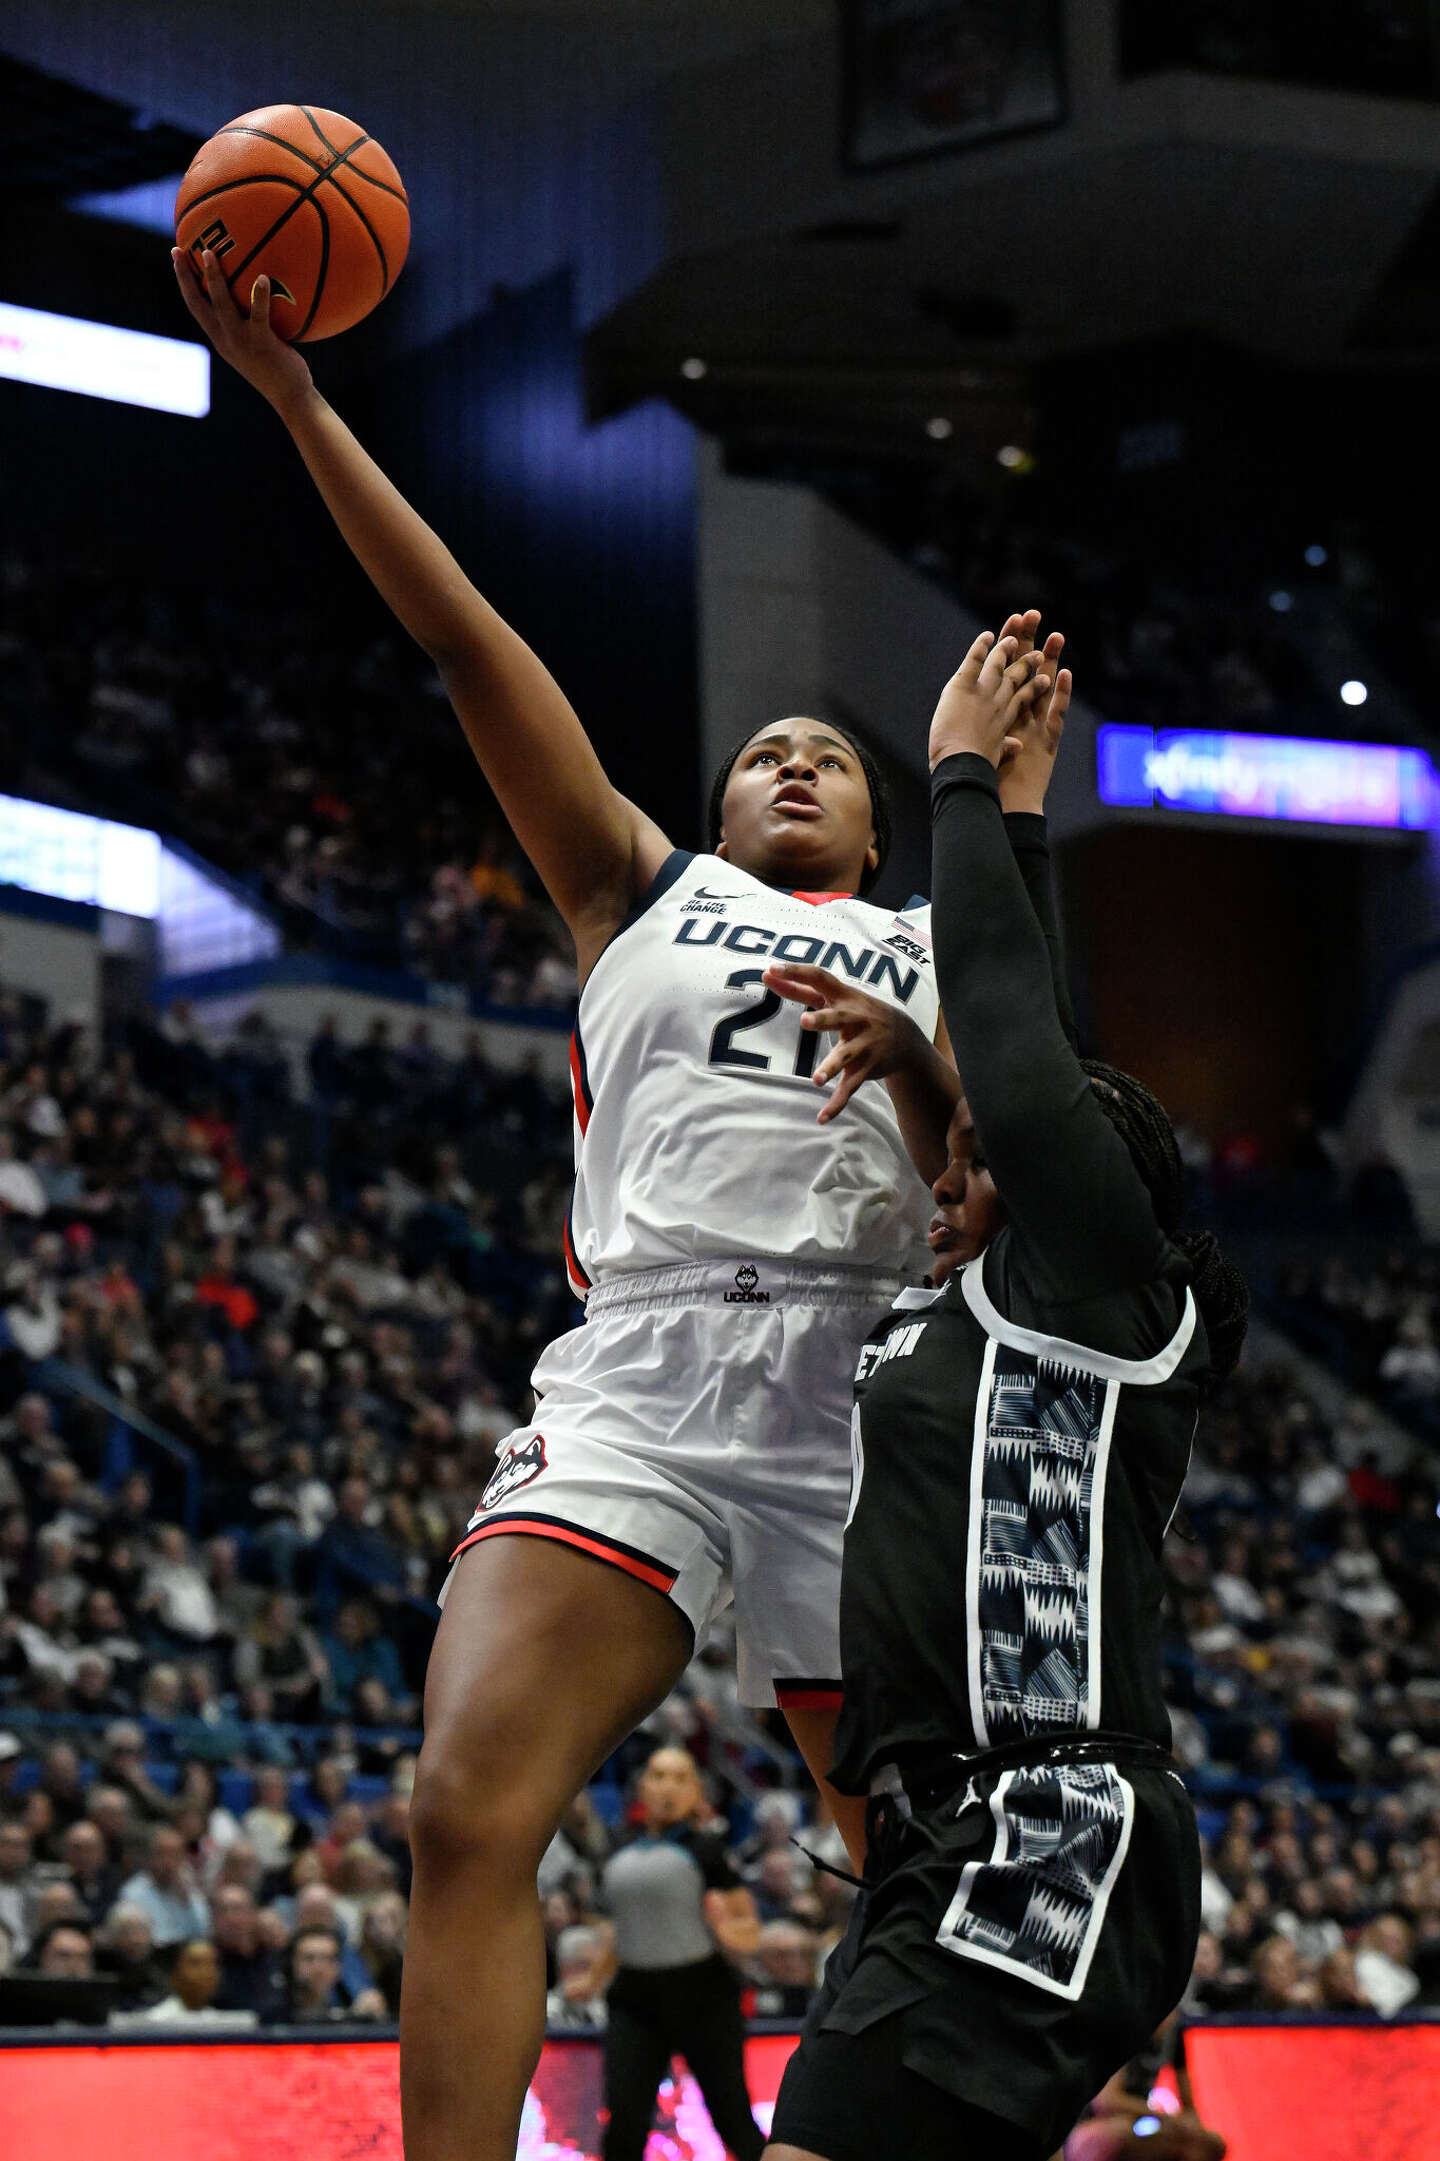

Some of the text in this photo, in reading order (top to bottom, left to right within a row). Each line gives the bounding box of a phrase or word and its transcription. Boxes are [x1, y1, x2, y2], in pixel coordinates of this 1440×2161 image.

[679, 903, 727, 915] CHANGE
[891, 934, 927, 955] BIG
[672, 918, 920, 1006] UCONN
[724, 1291, 770, 1303] UCONN
